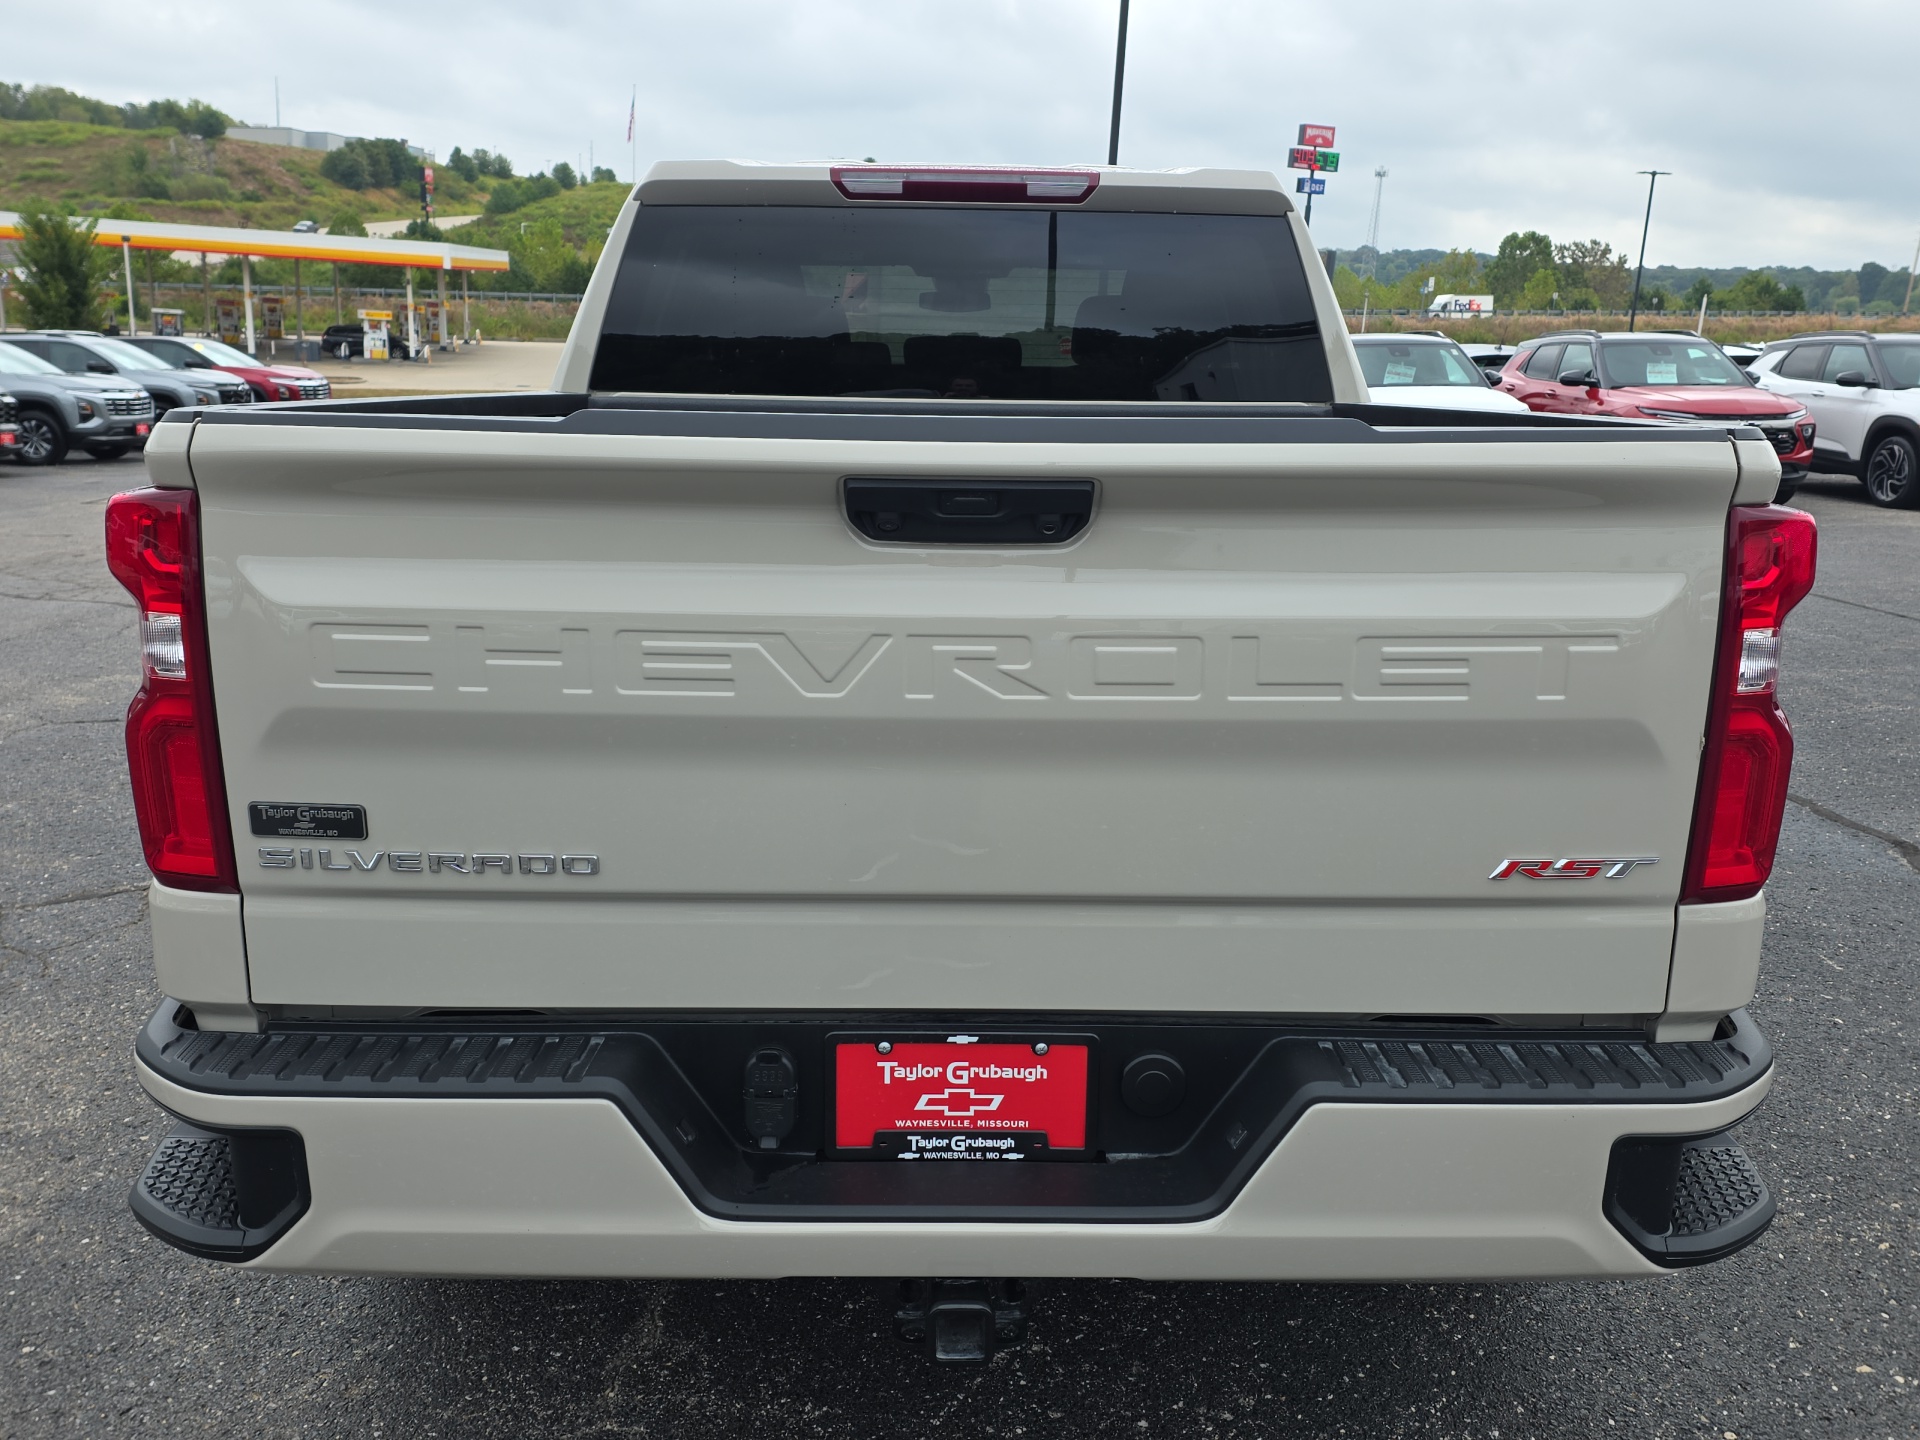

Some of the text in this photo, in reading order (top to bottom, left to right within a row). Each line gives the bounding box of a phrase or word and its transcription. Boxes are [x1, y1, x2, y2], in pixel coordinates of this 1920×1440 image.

[1311, 183, 1324, 192] DEF
[1454, 299, 1482, 311] FedEx
[308, 622, 1620, 702] CHEVROLET
[257, 805, 354, 822] Taylor Grubaugh
[278, 828, 326, 836] WAYNESVILLE,
[258, 846, 600, 876] SILVERADO
[1488, 856, 1660, 880] RST
[876, 1061, 1048, 1085] Taylor Grubaugh
[895, 1119, 1029, 1128] WAYNESVILLE, MISSOURI
[907, 1135, 1015, 1151] Taylor Grubaugh
[923, 1151, 1000, 1160] WAYNESVILLE, MO
